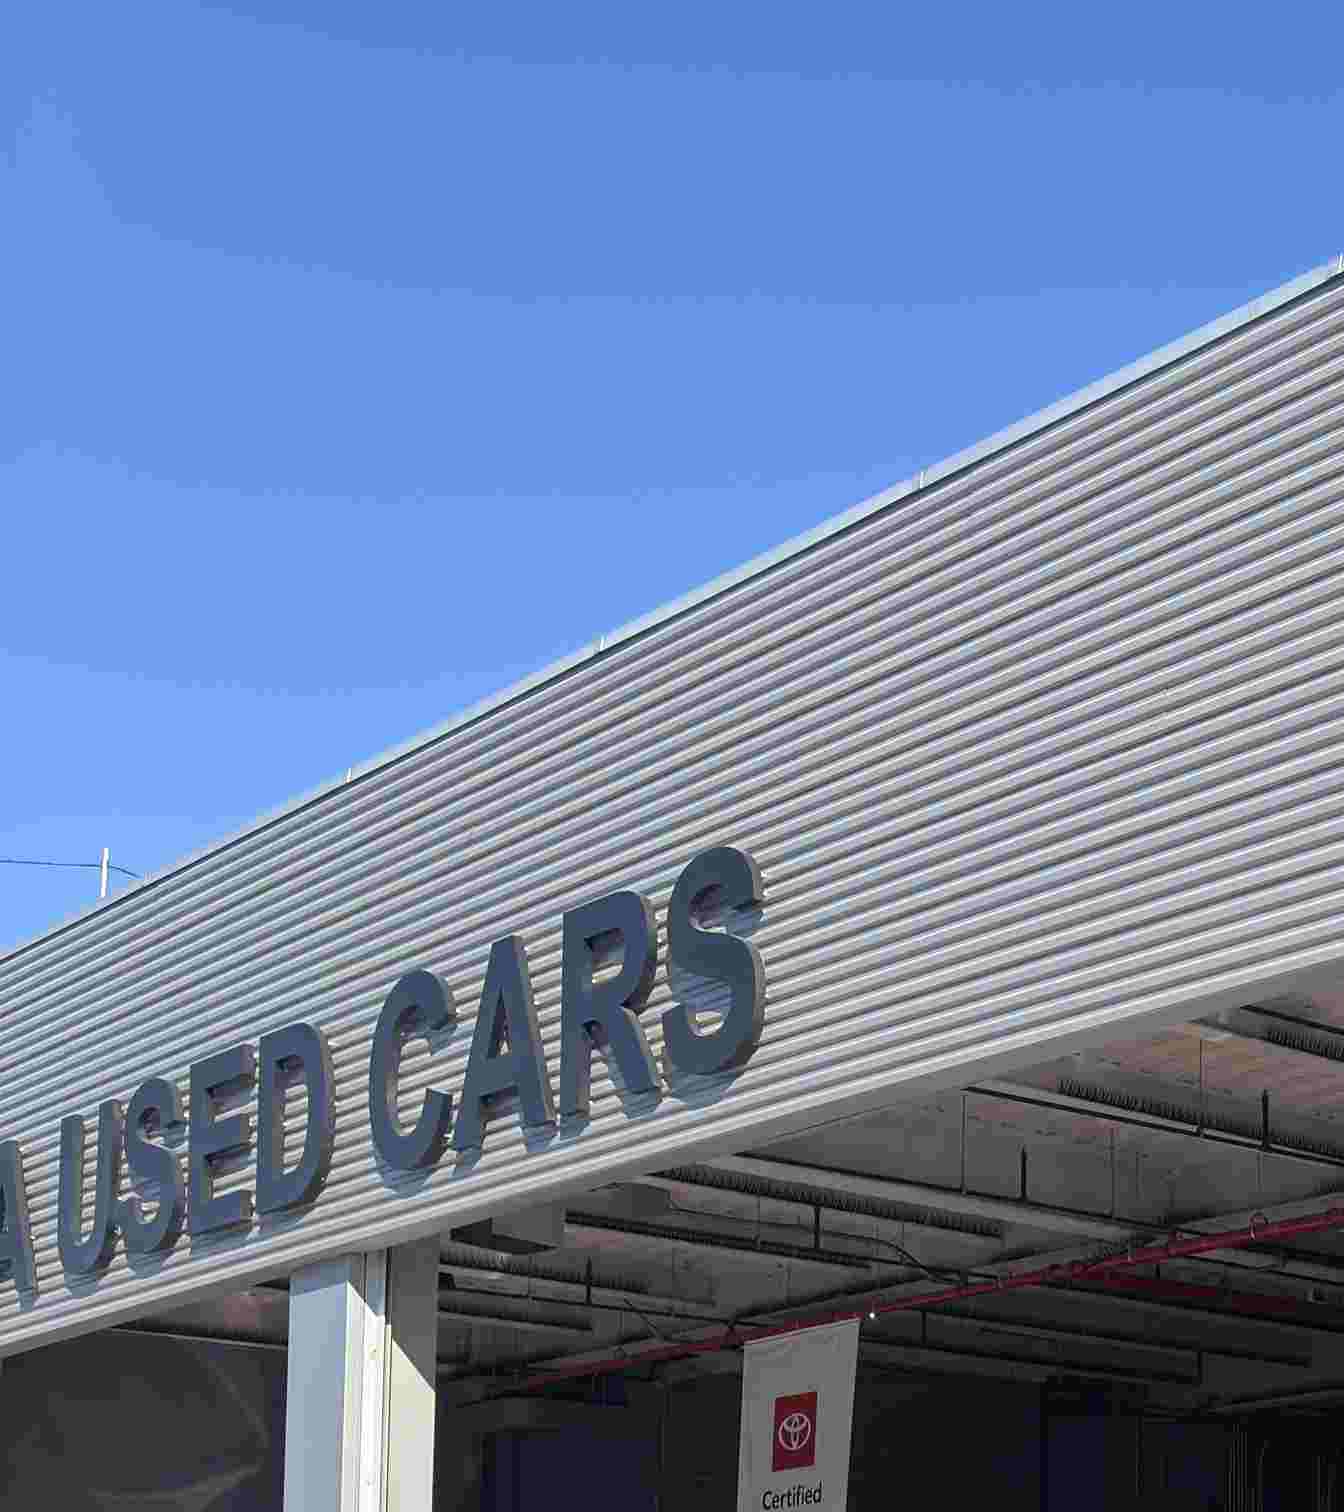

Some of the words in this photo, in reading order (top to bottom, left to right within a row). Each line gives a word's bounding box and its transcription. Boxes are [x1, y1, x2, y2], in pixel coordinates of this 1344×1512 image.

[58, 1022, 338, 1282] USED
[369, 846, 767, 1184] CARS
[761, 1480, 823, 1511] Certified
